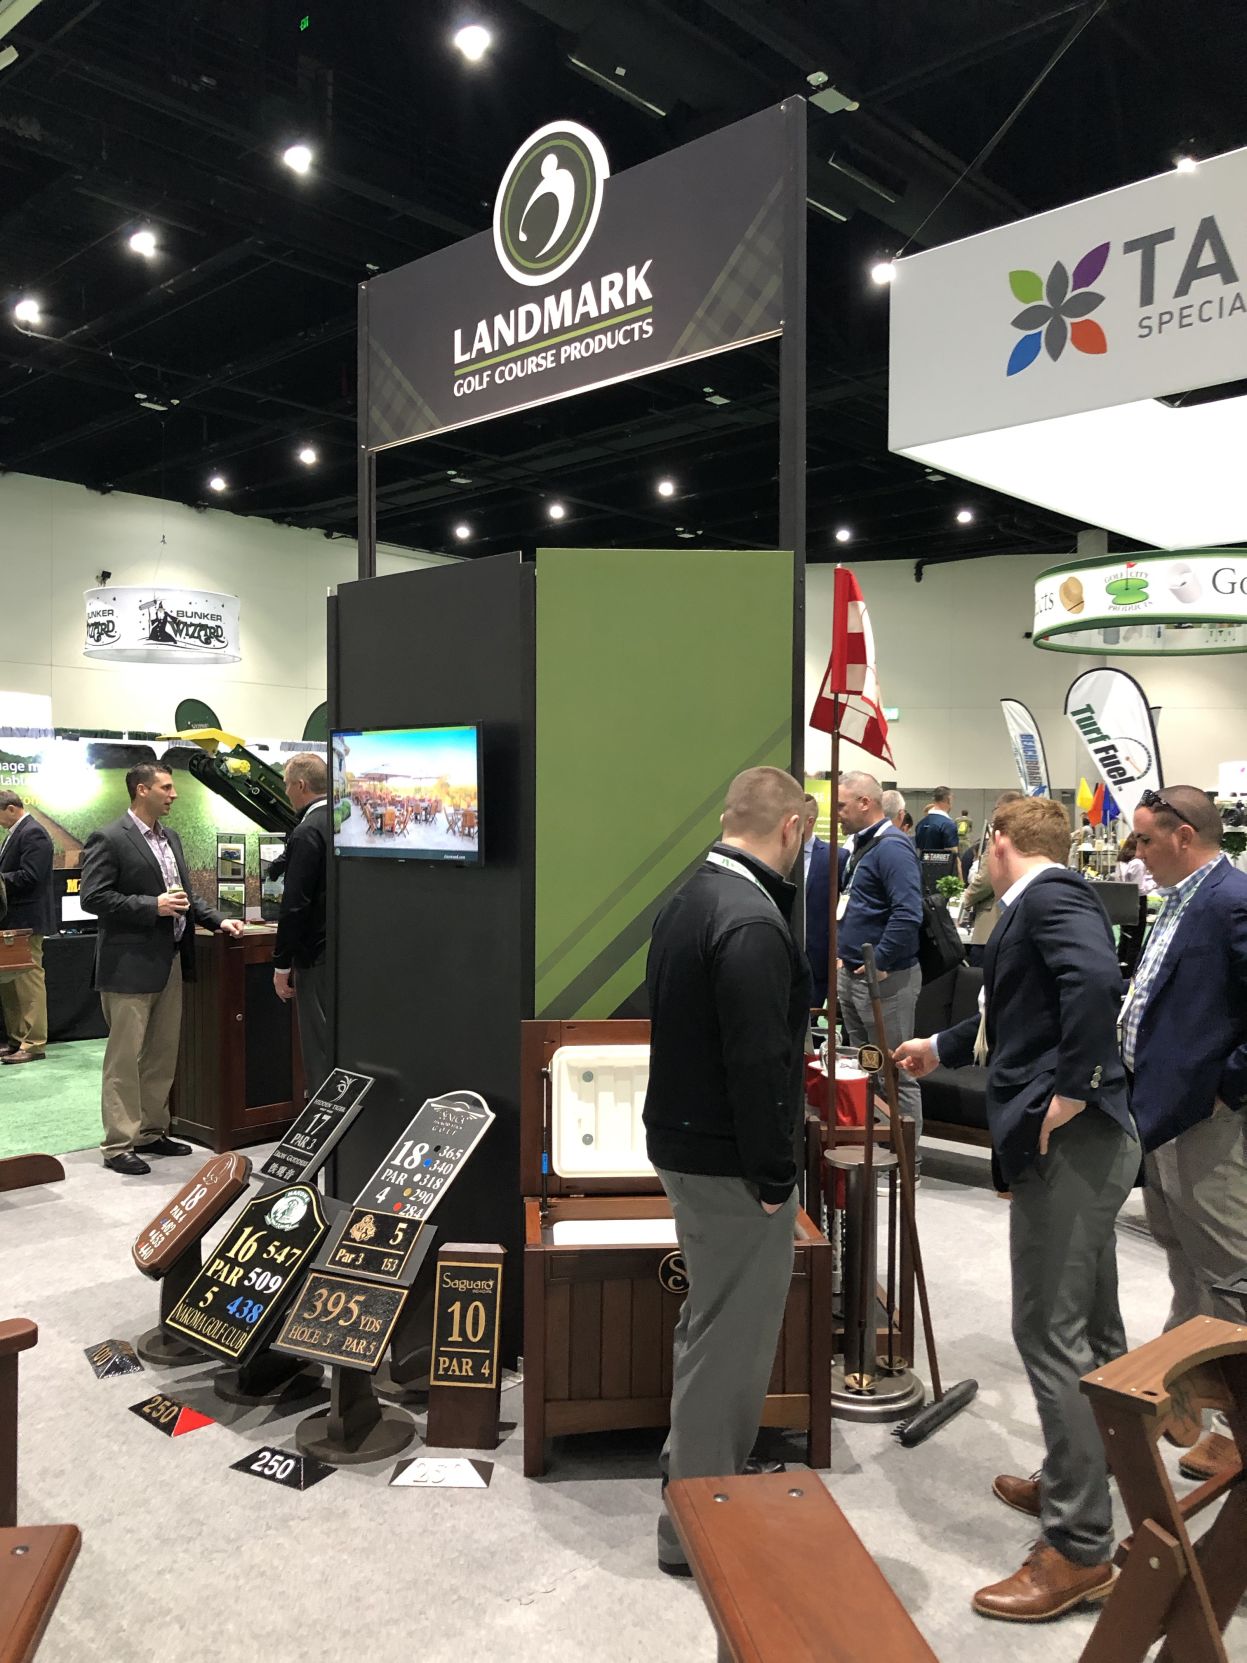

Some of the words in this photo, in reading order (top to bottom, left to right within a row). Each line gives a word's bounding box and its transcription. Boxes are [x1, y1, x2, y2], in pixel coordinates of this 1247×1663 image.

[454, 259, 653, 364] LANDMARK
[1137, 292, 1247, 338] SPECIA
[453, 371, 492, 397] GOLF
[494, 350, 556, 384] COURSE
[560, 318, 654, 364] PRODUCTS
[176, 610, 222, 622] BUNKER
[1070, 703, 1112, 744] Turf
[1094, 744, 1136, 786] Fuel
[305, 1113, 332, 1136] 17
[290, 1133, 309, 1148] PAR
[307, 1138, 317, 1150] 3
[391, 1140, 430, 1169] 18
[439, 1145, 464, 1161] 365
[381, 1168, 408, 1186] PAR
[419, 1174, 444, 1190] 318
[429, 1160, 454, 1175] 340
[180, 1184, 207, 1211] 18
[375, 1186, 391, 1203] 4
[409, 1188, 434, 1205] 290
[226, 1226, 268, 1263] 16
[262, 1240, 302, 1267] 547
[389, 1223, 408, 1245] 5
[335, 1248, 354, 1264] Par
[355, 1253, 365, 1265] 3
[381, 1258, 399, 1272] 153
[205, 1258, 244, 1287] PAR
[243, 1267, 283, 1294] 509
[442, 1272, 494, 1292] Saguaro
[199, 1286, 220, 1308] 5
[226, 1295, 264, 1324] 438
[303, 1288, 366, 1326] 395
[359, 1315, 383, 1333] YDS
[172, 1303, 208, 1331] NAKOMA
[202, 1317, 229, 1340] GOLF
[221, 1326, 248, 1350] CLUB
[447, 1301, 486, 1343] 10
[288, 1325, 322, 1343] HOLE
[323, 1333, 333, 1346] 3
[342, 1336, 368, 1354] PAR
[367, 1342, 377, 1355] 5
[437, 1357, 474, 1376] PAR
[481, 1360, 490, 1377] 4
[142, 1395, 179, 1423] 250
[250, 1451, 296, 1479] 250
